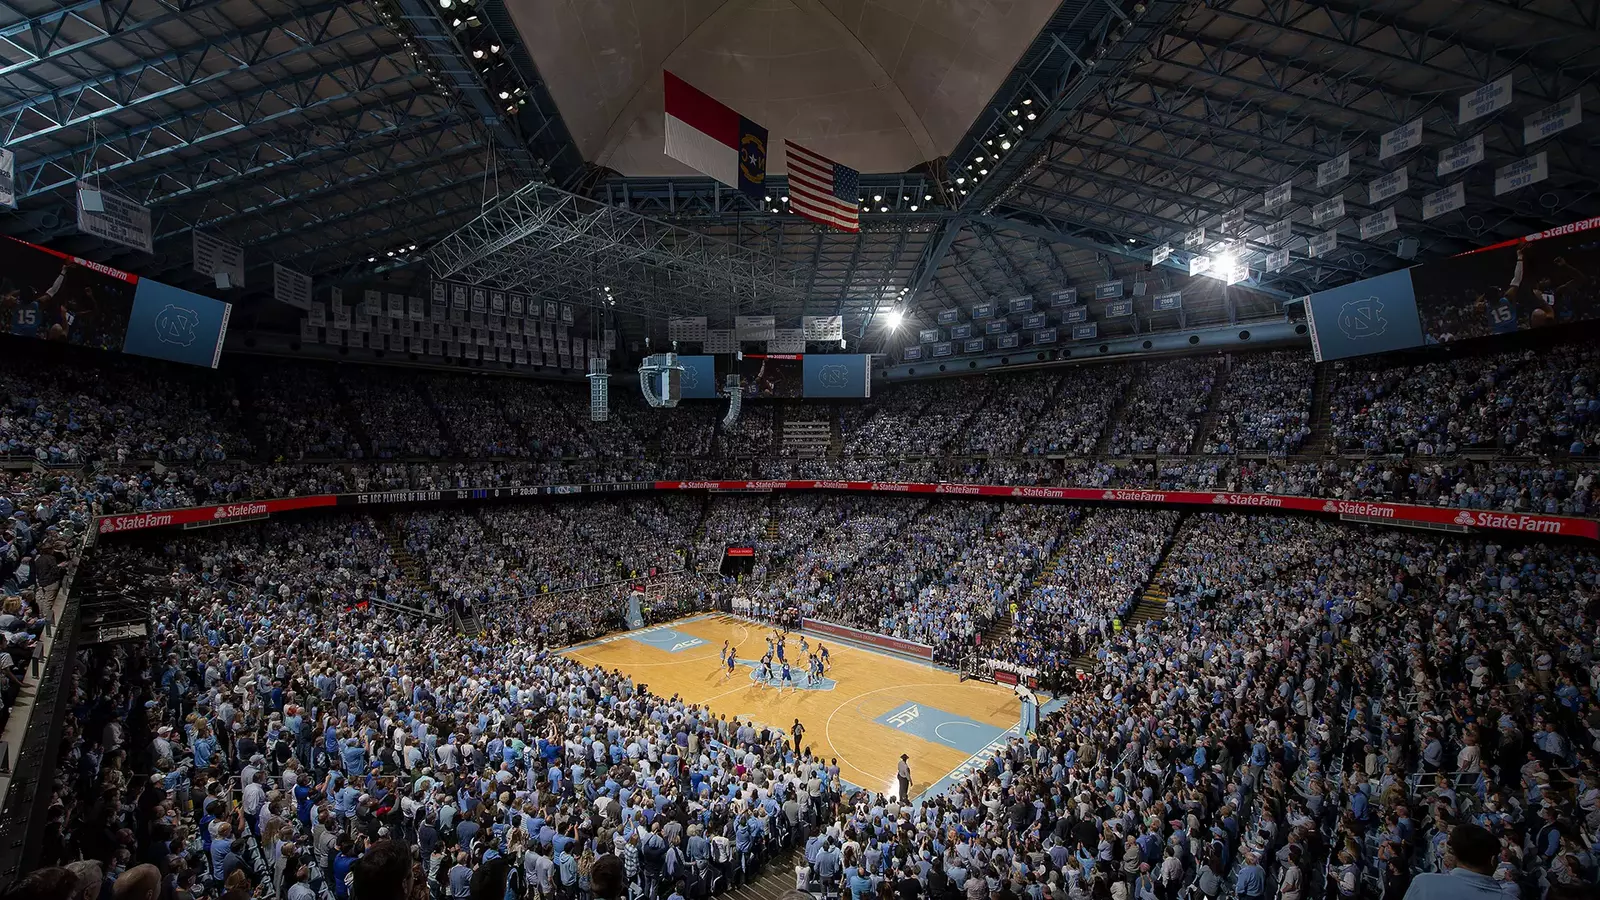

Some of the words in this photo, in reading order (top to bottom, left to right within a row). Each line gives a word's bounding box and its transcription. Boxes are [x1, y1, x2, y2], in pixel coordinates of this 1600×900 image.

[1476, 101, 1494, 115] 1977
[1510, 174, 1532, 187] 2017
[16, 309, 36, 325] 15
[1491, 306, 1512, 324] 15
[357, 494, 368, 504] 15
[370, 493, 381, 503] ACC
[383, 492, 407, 503] PLAYERS
[408, 492, 415, 502] OF
[416, 491, 426, 501] THE
[428, 491, 441, 500] YEAR
[520, 487, 538, 496] 20:00
[671, 638, 703, 652] ACC
[886, 704, 919, 728] ACC
